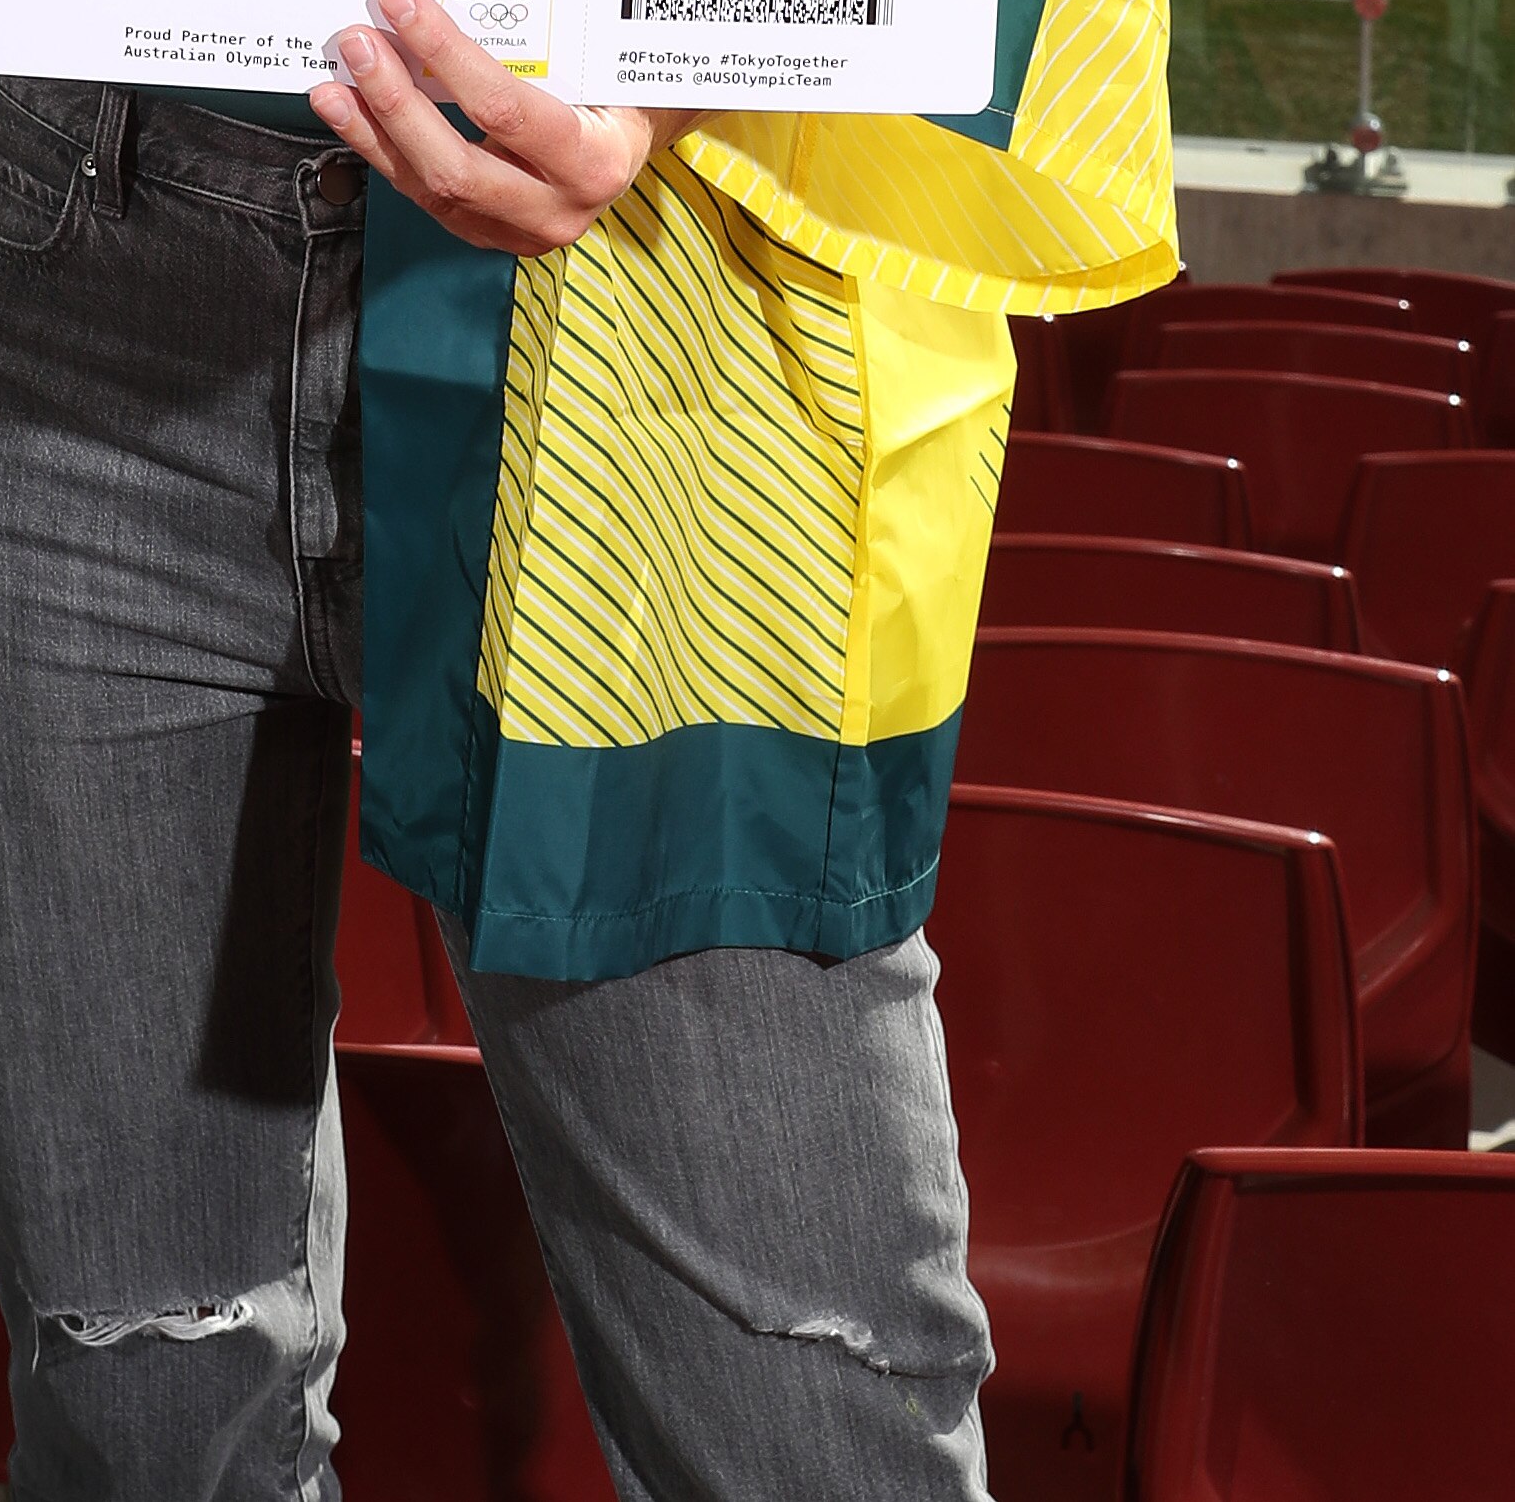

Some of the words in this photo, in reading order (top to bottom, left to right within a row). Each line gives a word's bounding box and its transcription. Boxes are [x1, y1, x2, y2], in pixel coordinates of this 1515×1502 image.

[125, 26, 171, 41] Proud
[182, 30, 247, 46] Partner
[256, 34, 274, 48] of
[285, 32, 313, 49] the
[474, 37, 527, 47] USTRALIA
[124, 44, 216, 62] Australian
[226, 51, 290, 69] Olympic
[301, 55, 339, 72] Team
[618, 50, 710, 68] #QFtoTokyo
[720, 53, 848, 71] #TokyoTogether
[616, 69, 683, 84] @Qantas
[692, 71, 832, 88] @AUSOlympicTeam
